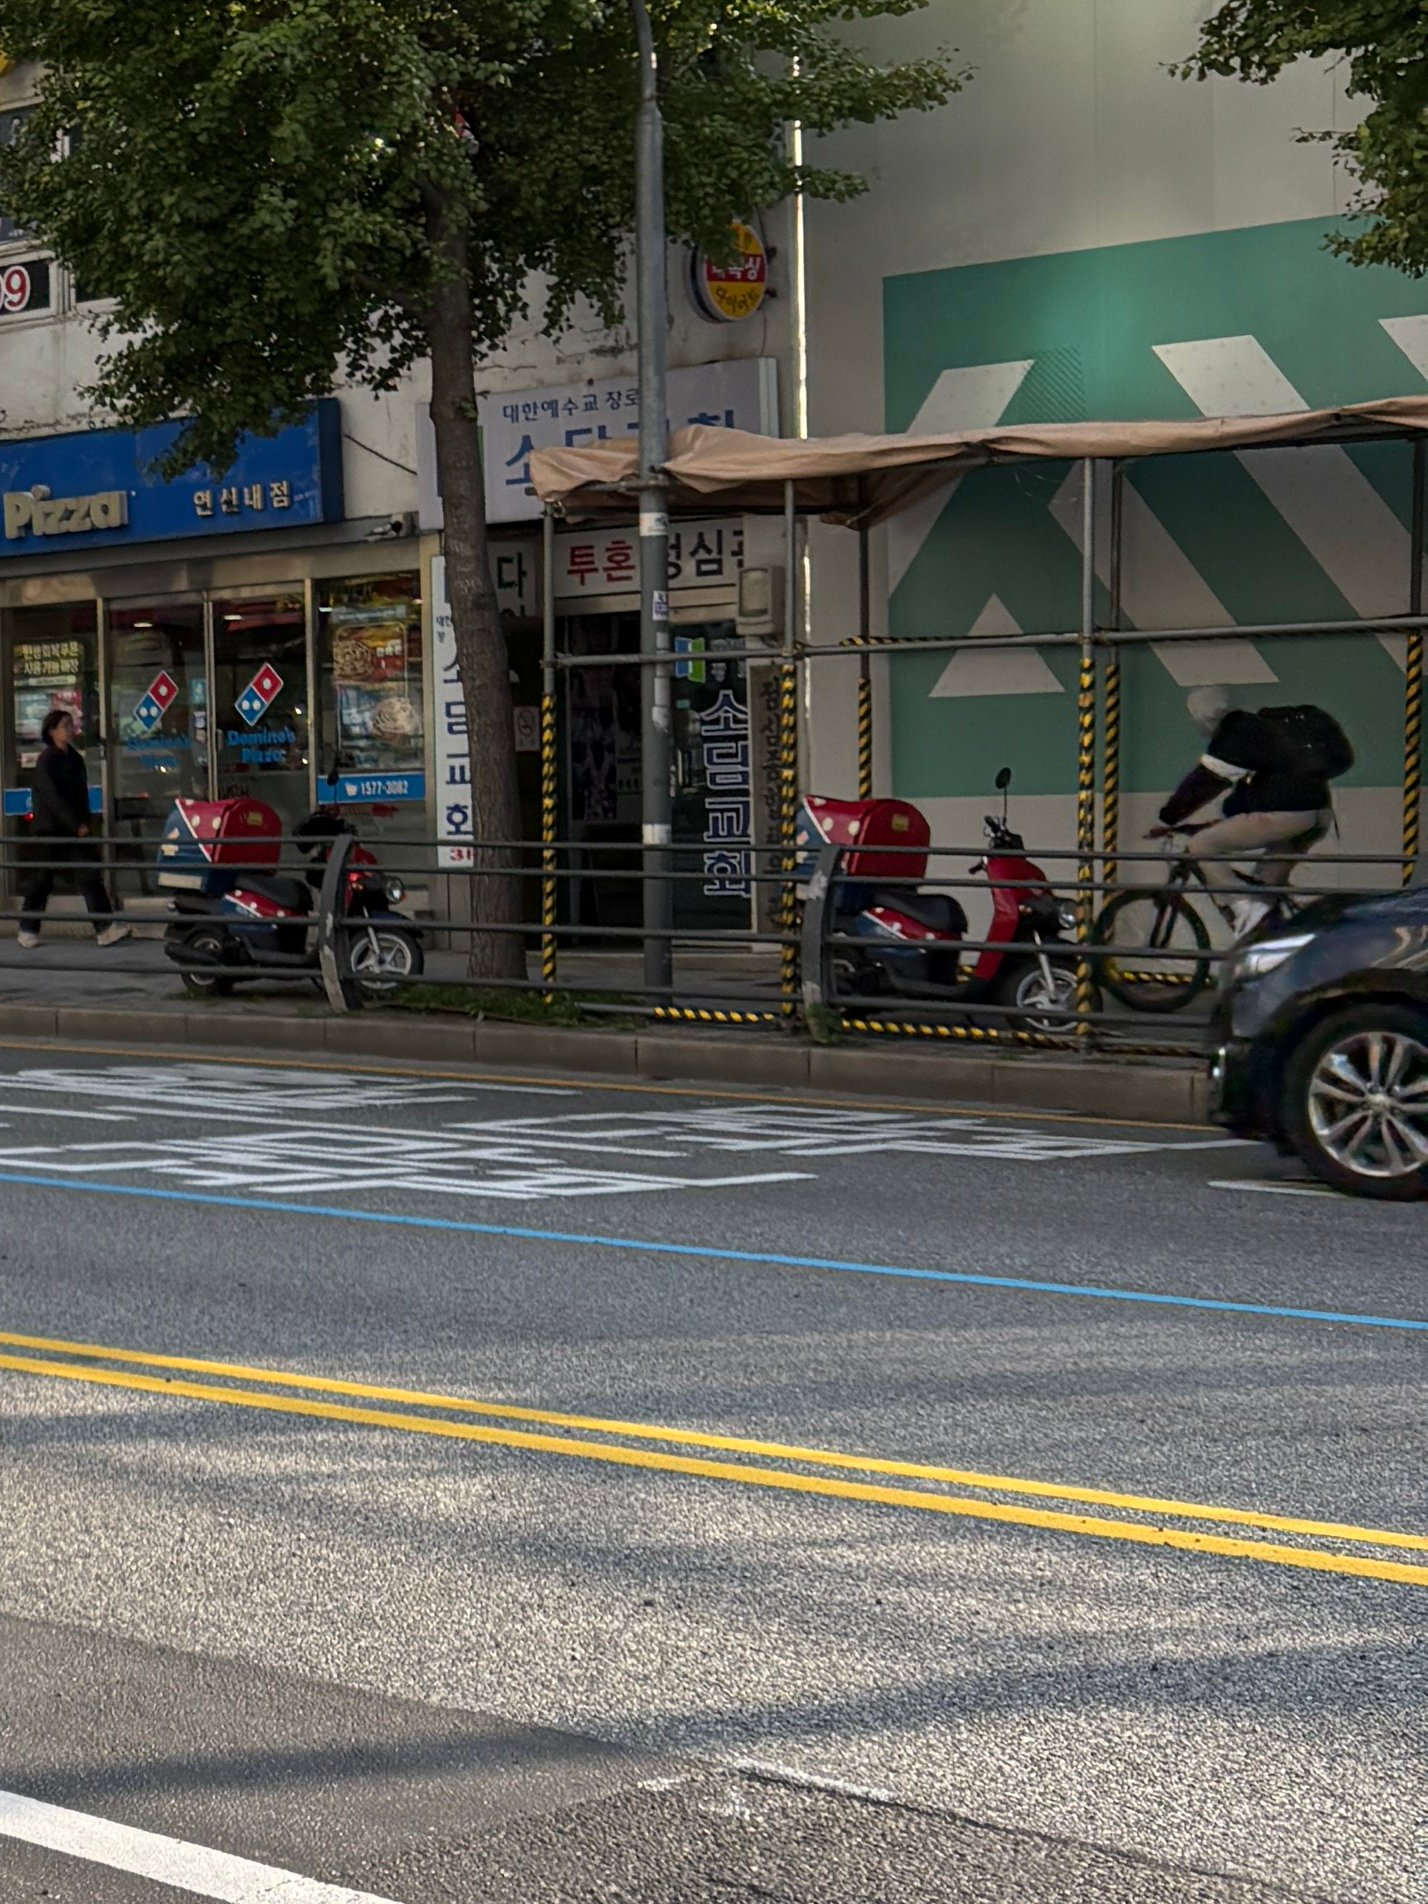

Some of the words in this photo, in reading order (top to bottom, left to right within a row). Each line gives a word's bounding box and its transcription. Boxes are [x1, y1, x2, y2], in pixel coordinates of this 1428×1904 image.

[502, 392, 600, 423] 대한예수교
[2, 483, 129, 540] Pizza
[192, 479, 291, 517] 연신내점
[567, 539, 636, 586] 투혼
[700, 689, 752, 899] 소담교회
